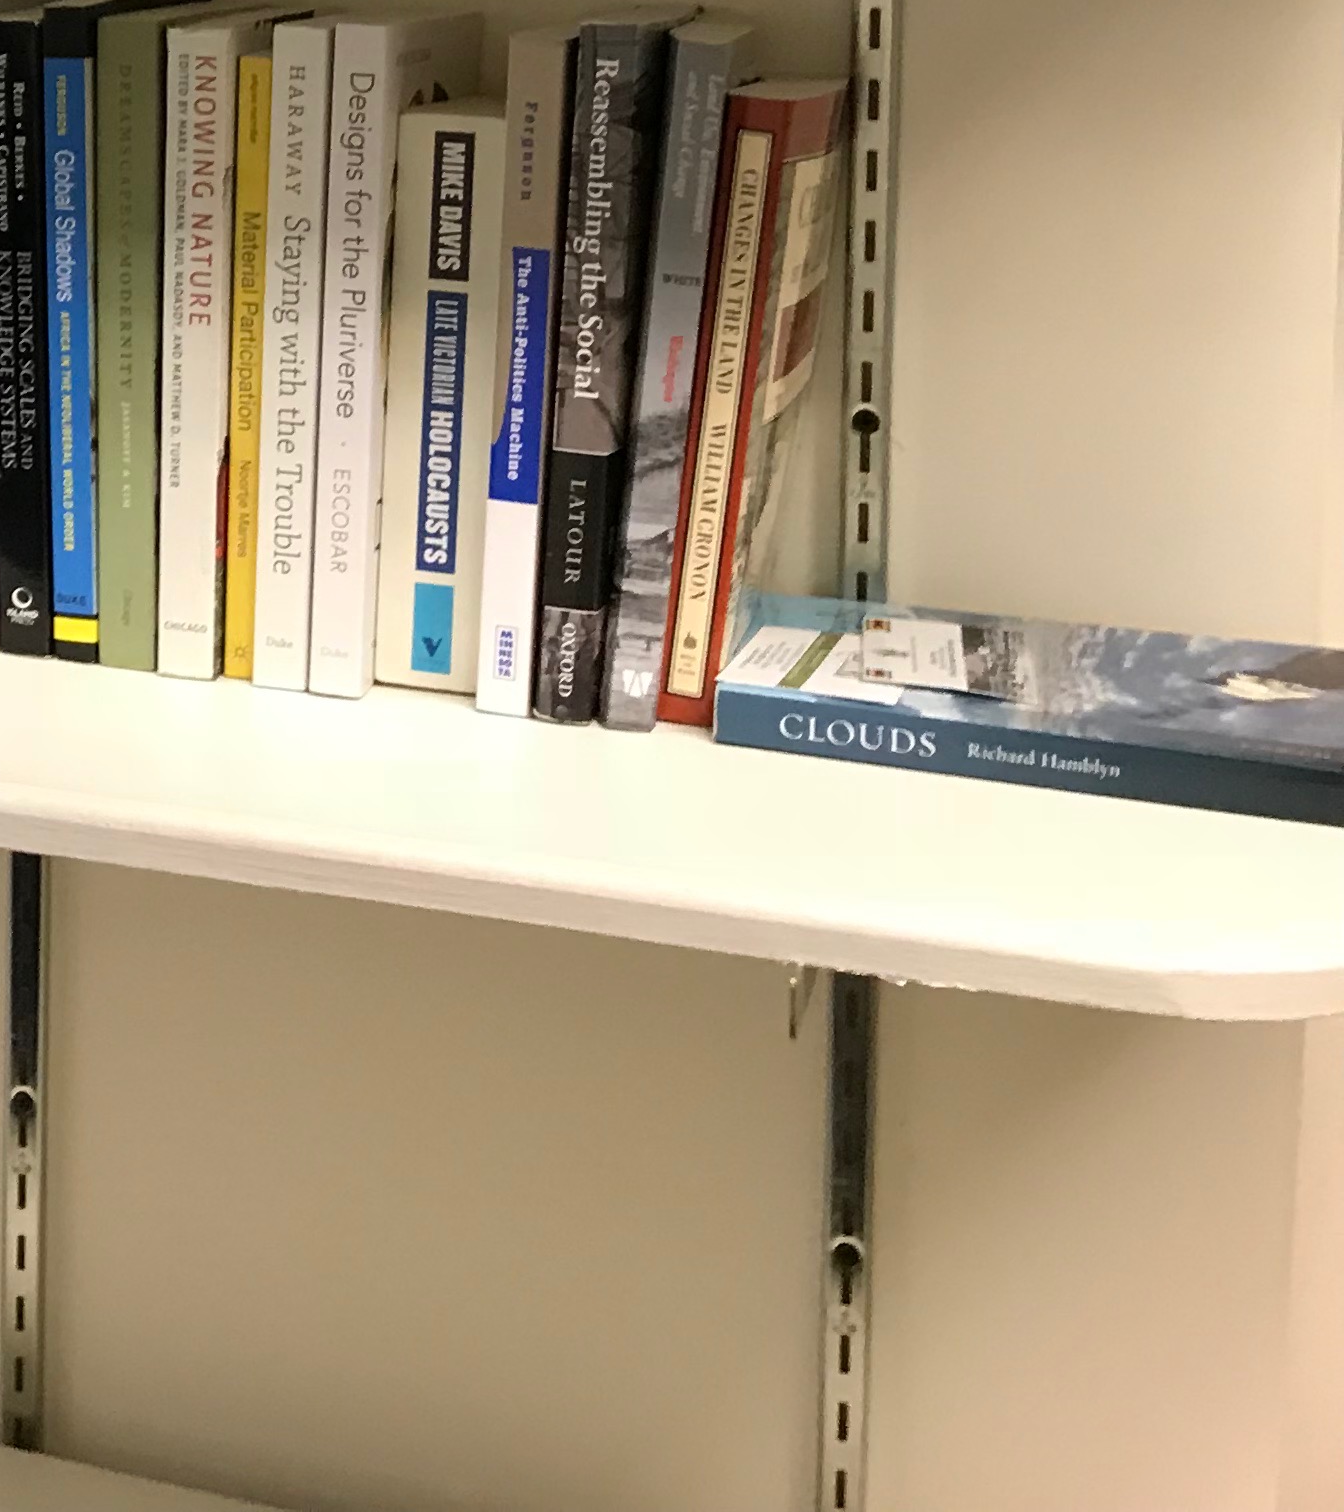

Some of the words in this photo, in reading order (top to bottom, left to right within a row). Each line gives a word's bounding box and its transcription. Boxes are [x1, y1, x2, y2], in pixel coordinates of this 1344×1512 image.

[192, 55, 217, 199] KNOWING
[284, 64, 308, 196] HARAWAY
[340, 72, 377, 183] Designs
[574, 58, 621, 254] Reassembling
[53, 150, 77, 211] Global
[343, 188, 373, 229] for
[439, 141, 466, 201] MIKE
[240, 211, 263, 296] Material
[340, 235, 368, 280] the
[436, 205, 465, 272] DAVIS
[730, 168, 759, 263] CHANGES
[16, 250, 35, 353] BRIDGING
[54, 216, 77, 302] Shadows
[188, 211, 213, 328] NATURE
[275, 215, 312, 325] Staying
[515, 255, 533, 288] The
[575, 262, 608, 308] the
[728, 269, 750, 292] IN
[335, 288, 366, 419] Pluriverse
[433, 299, 461, 330] LATE
[510, 293, 532, 403] Anti-Politics
[572, 314, 604, 400] Social
[723, 295, 746, 336] THE
[18, 359, 37, 430] SCALES
[237, 301, 260, 432] Participation
[277, 332, 308, 397] with
[430, 334, 459, 405] VICTORIAN
[715, 339, 741, 396] LAND
[0, 382, 18, 470] SYSTEMS
[18, 433, 35, 471] AND
[275, 407, 305, 455] the
[506, 407, 526, 482] Machine
[424, 411, 457, 565] HOLOCAUSTS
[699, 424, 729, 514] WILLIAM
[272, 463, 305, 576] Trouble
[328, 468, 354, 575] ESCOBAR
[564, 479, 588, 585] LATOUR
[688, 517, 717, 603] CRONON
[558, 622, 579, 698] OXFORD
[778, 711, 939, 758] CLOUDS
[967, 741, 1035, 768] Richard
[1041, 750, 1122, 780] Hamblyn
